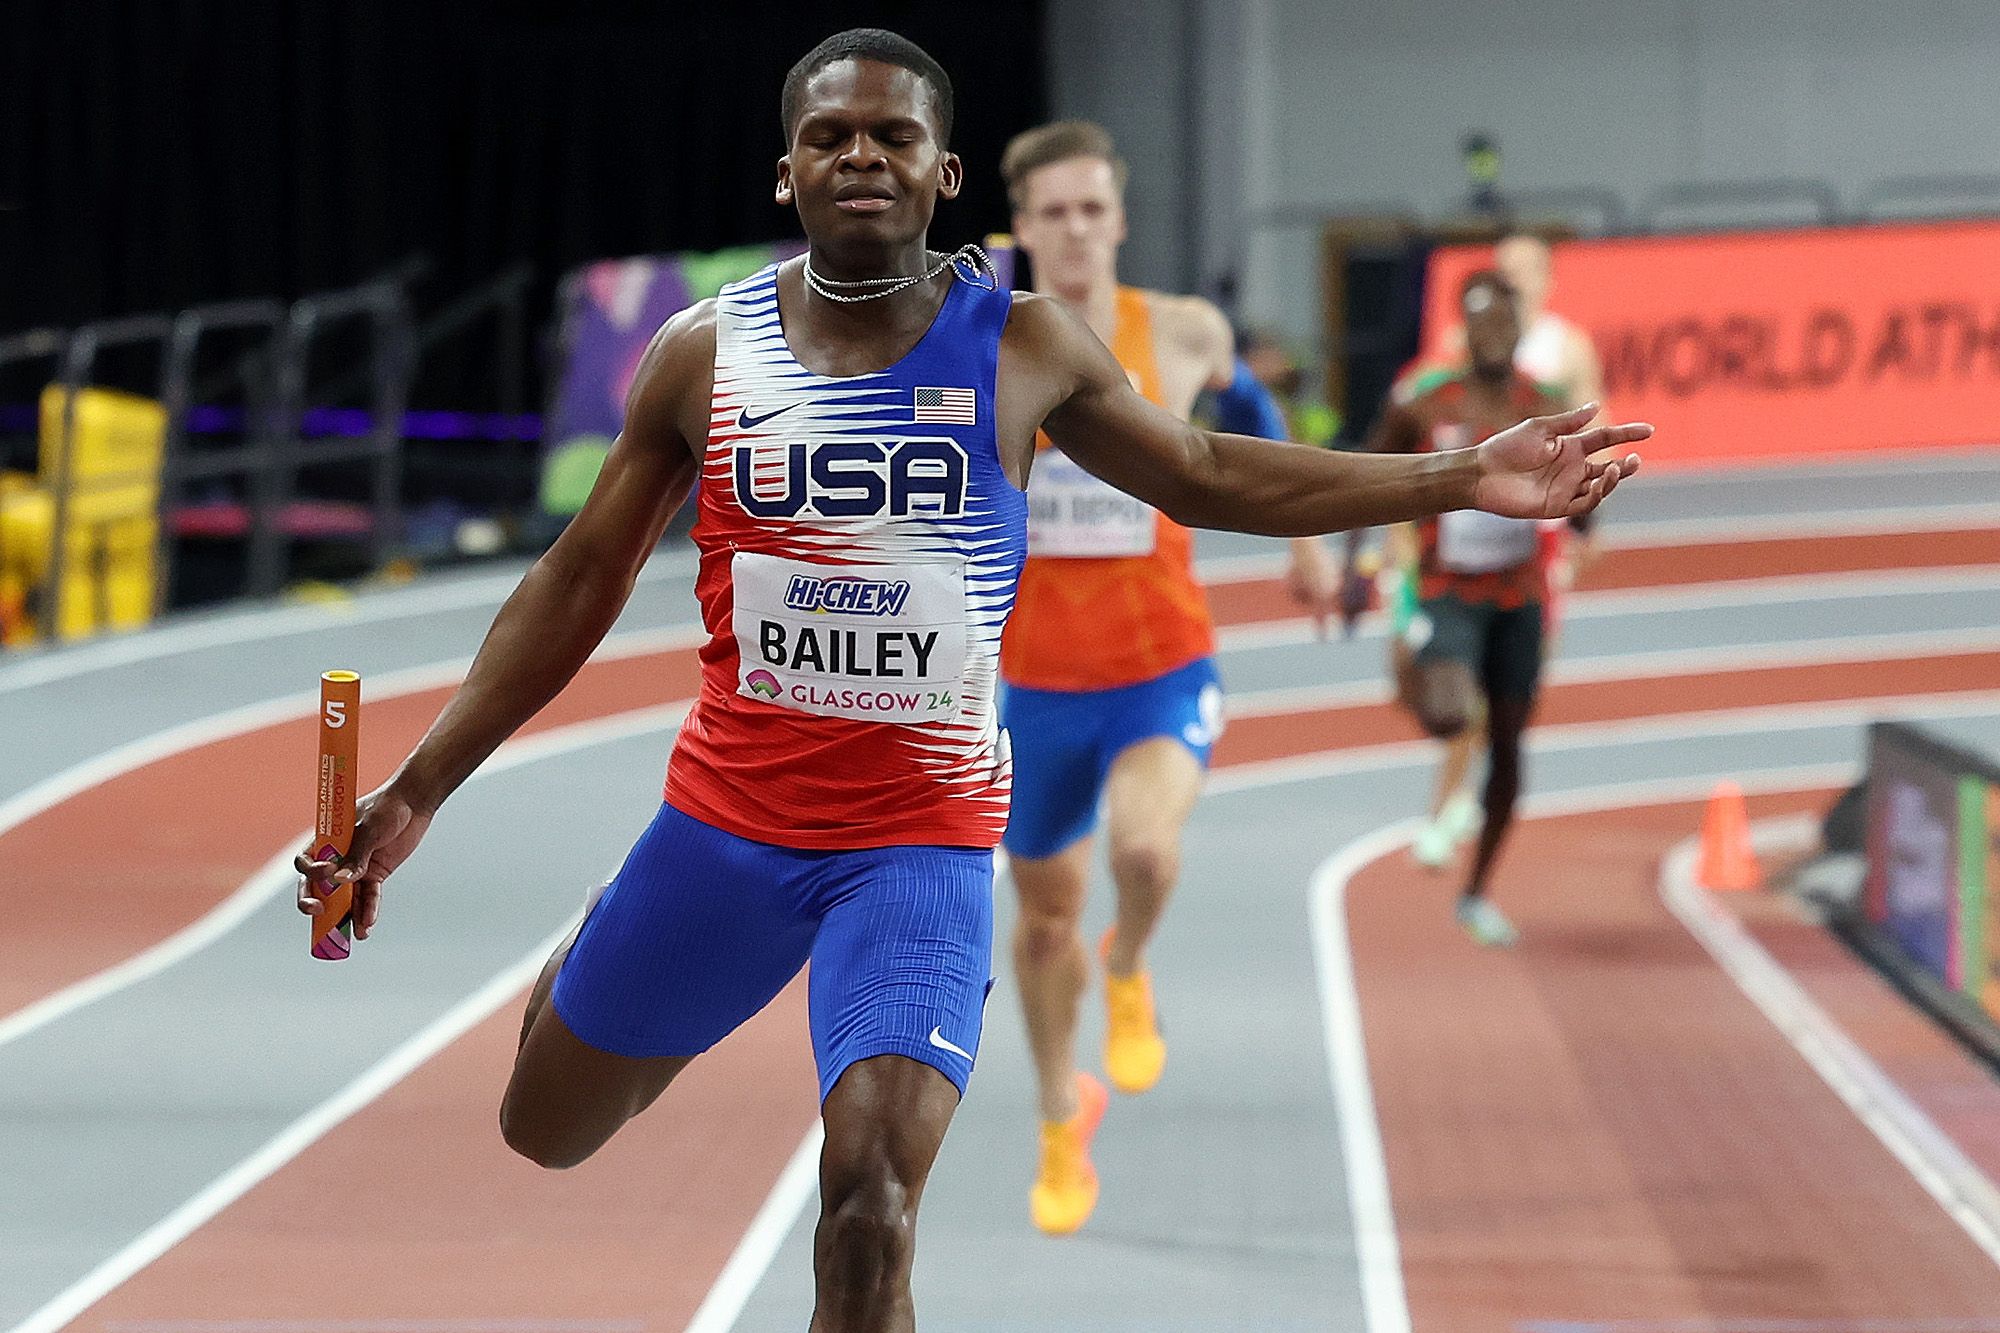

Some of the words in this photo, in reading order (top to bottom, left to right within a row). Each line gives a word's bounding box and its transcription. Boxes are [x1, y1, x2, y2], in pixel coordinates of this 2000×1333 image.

[1599, 308, 1856, 396] WORLD
[733, 437, 968, 519] USA
[784, 574, 911, 617] HI-CHEW
[760, 620, 939, 678] BAILEY
[324, 700, 346, 728] 5
[790, 684, 921, 711] GLASGOW
[926, 690, 953, 711] 24
[332, 773, 345, 835] GLASGOW
